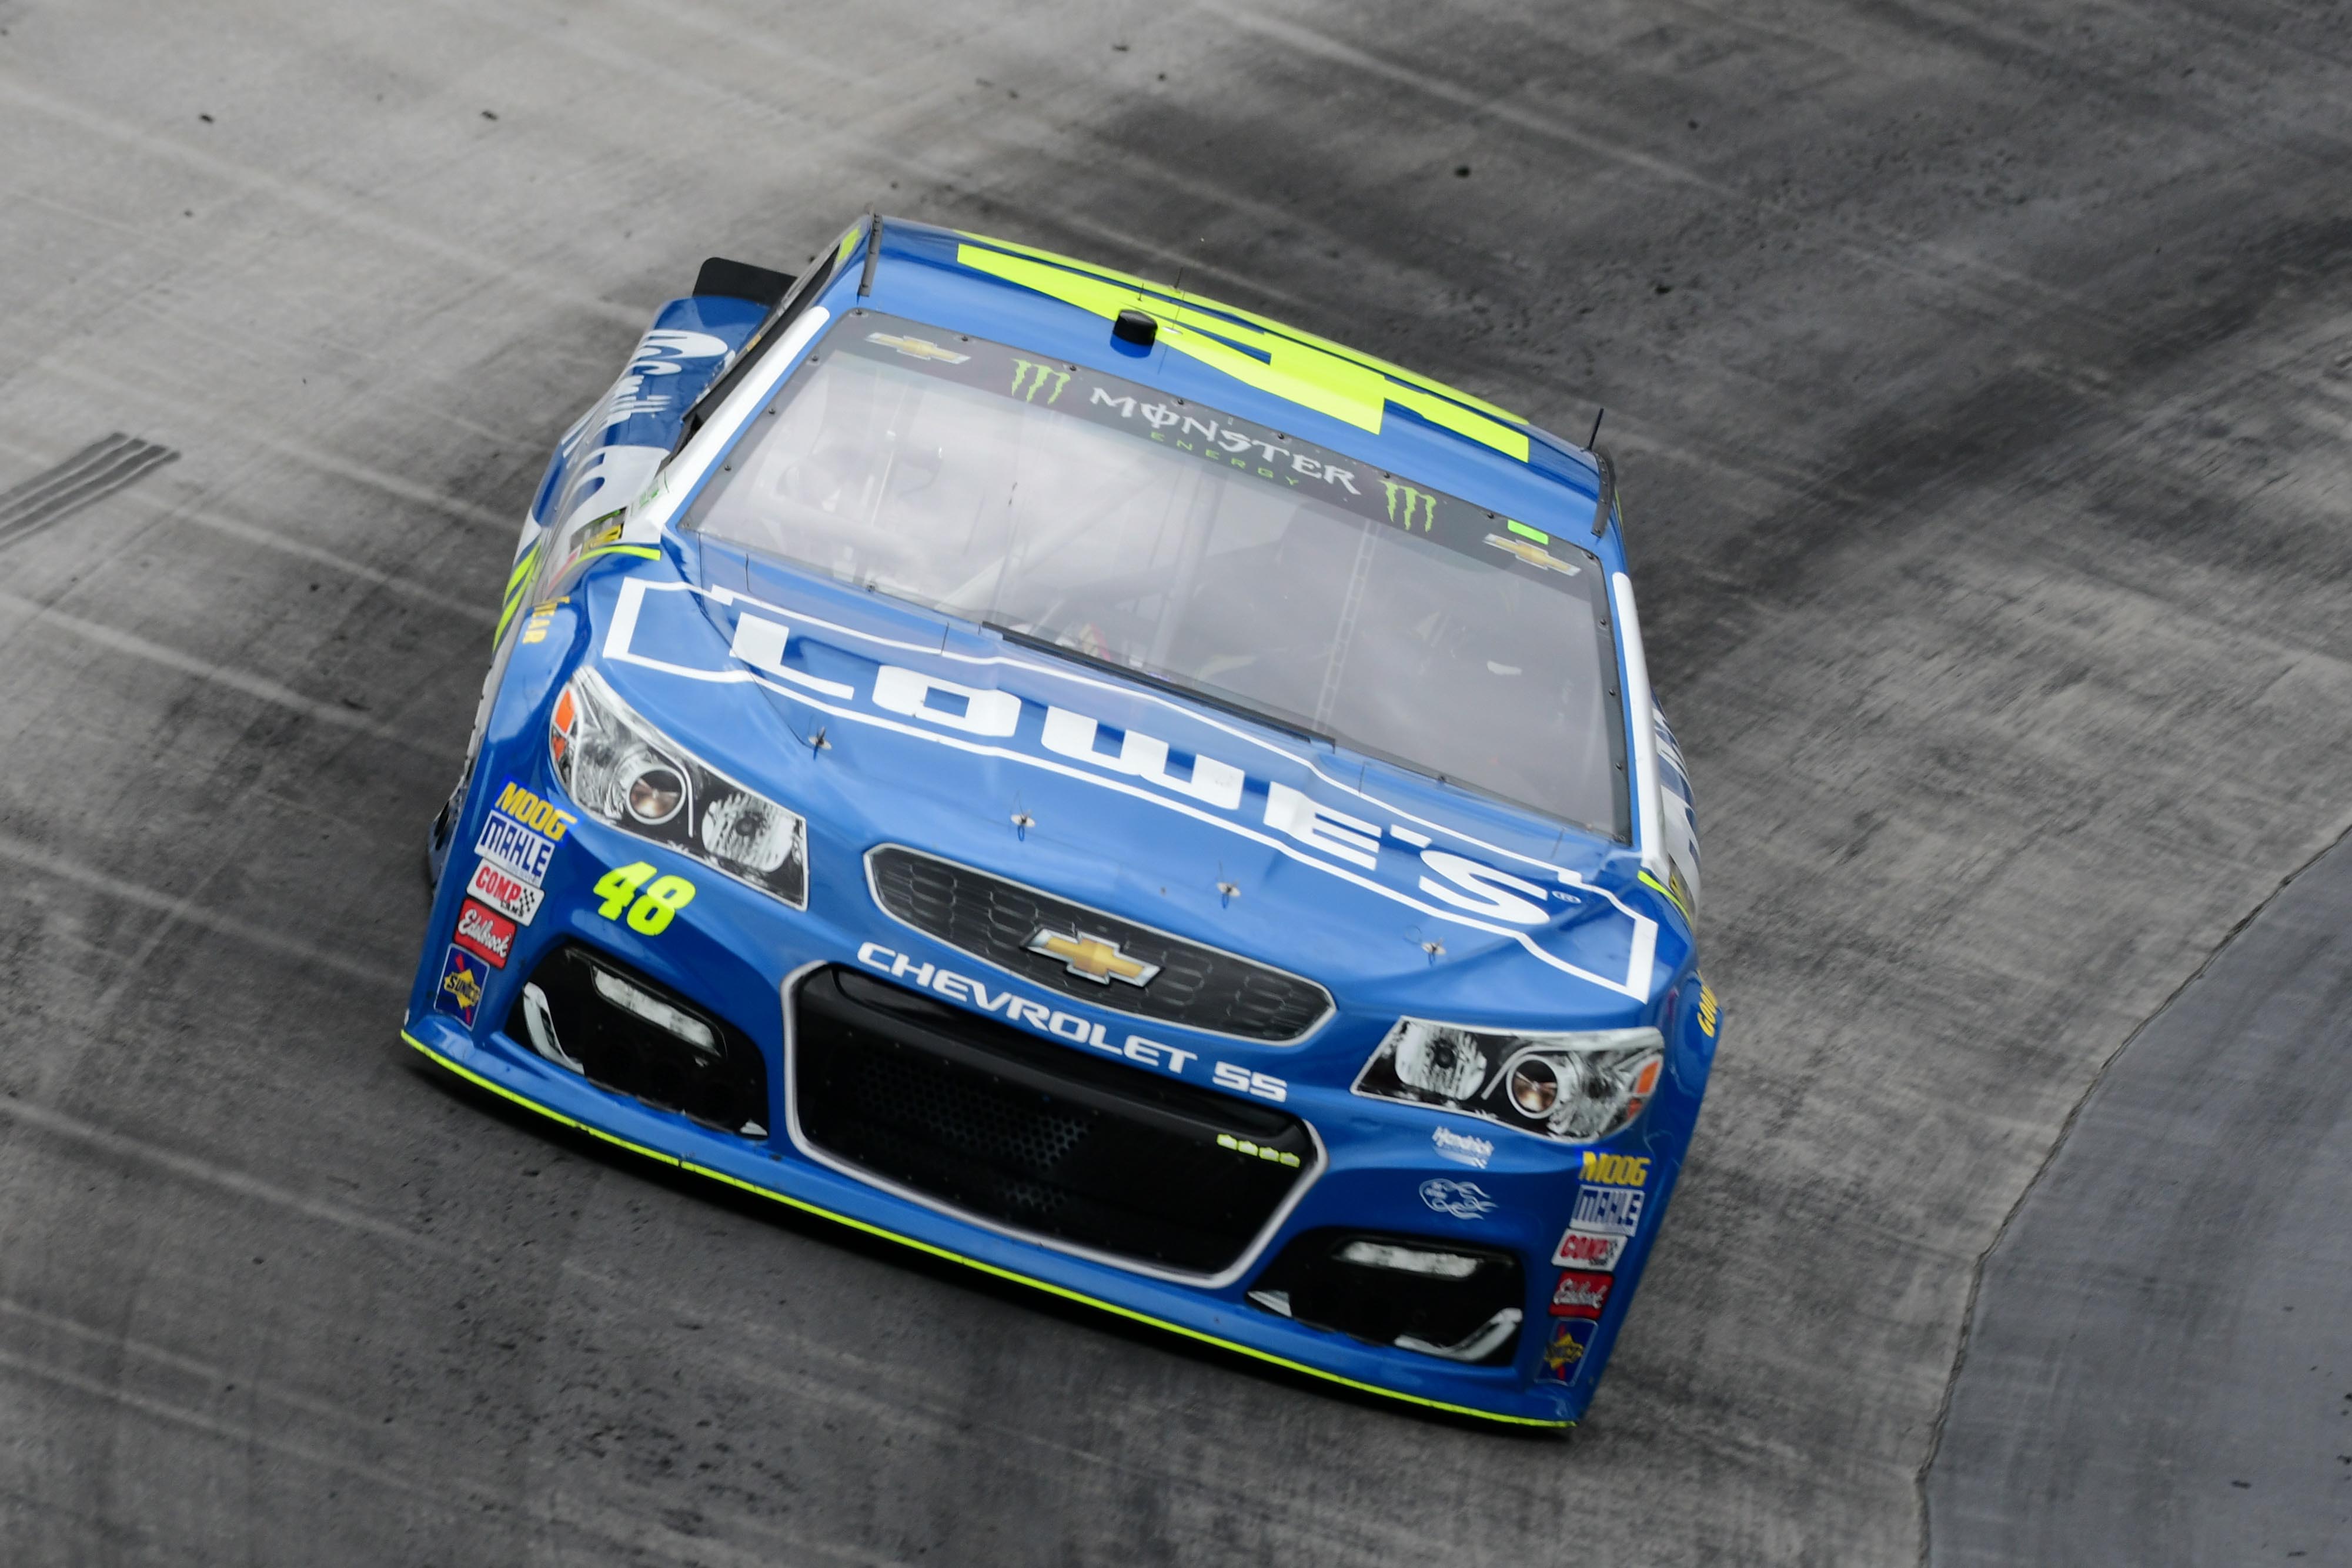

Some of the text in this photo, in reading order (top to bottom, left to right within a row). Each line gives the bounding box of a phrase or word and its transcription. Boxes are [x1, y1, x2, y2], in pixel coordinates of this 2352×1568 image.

[1089, 387, 1361, 495] MONSTER
[1151, 432, 1299, 485] ENERGY
[730, 613, 1551, 925] LOWE'S
[495, 781, 578, 842] MOOG
[480, 814, 552, 878] MAHLE
[475, 865, 522, 904] COMP
[593, 861, 696, 936] 48
[857, 941, 1288, 1103] CHEVROLET SS
[1578, 1151, 1651, 1187] MOOG
